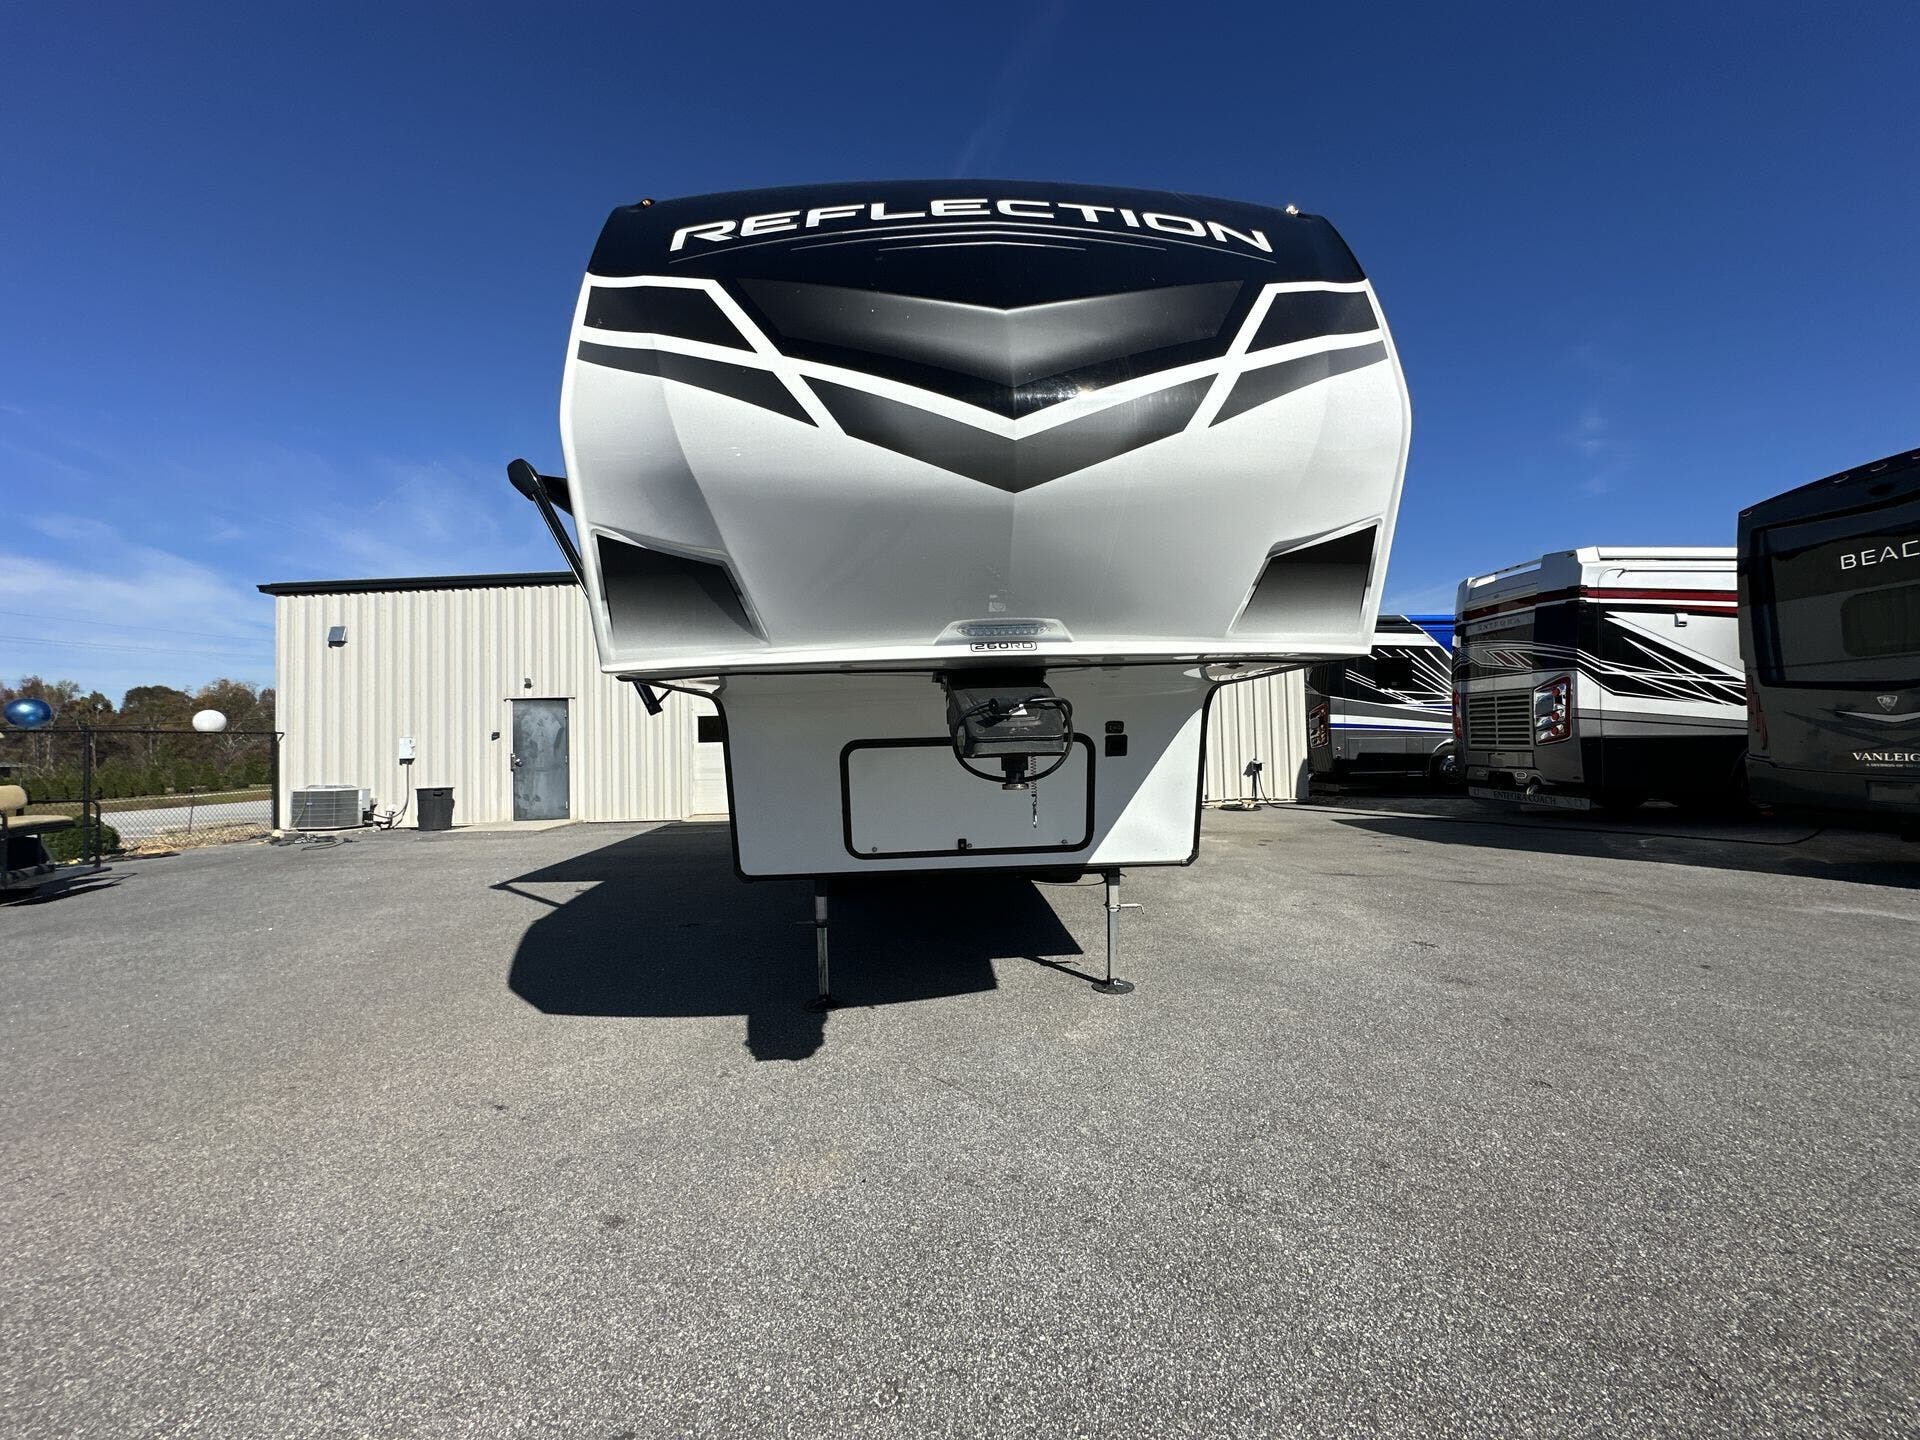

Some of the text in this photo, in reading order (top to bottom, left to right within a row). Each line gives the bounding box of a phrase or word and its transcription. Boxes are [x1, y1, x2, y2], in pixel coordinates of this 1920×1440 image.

[669, 198, 1273, 252] REFLECTION
[1840, 540, 1920, 569] BEAC
[975, 642, 1033, 650] 260RD
